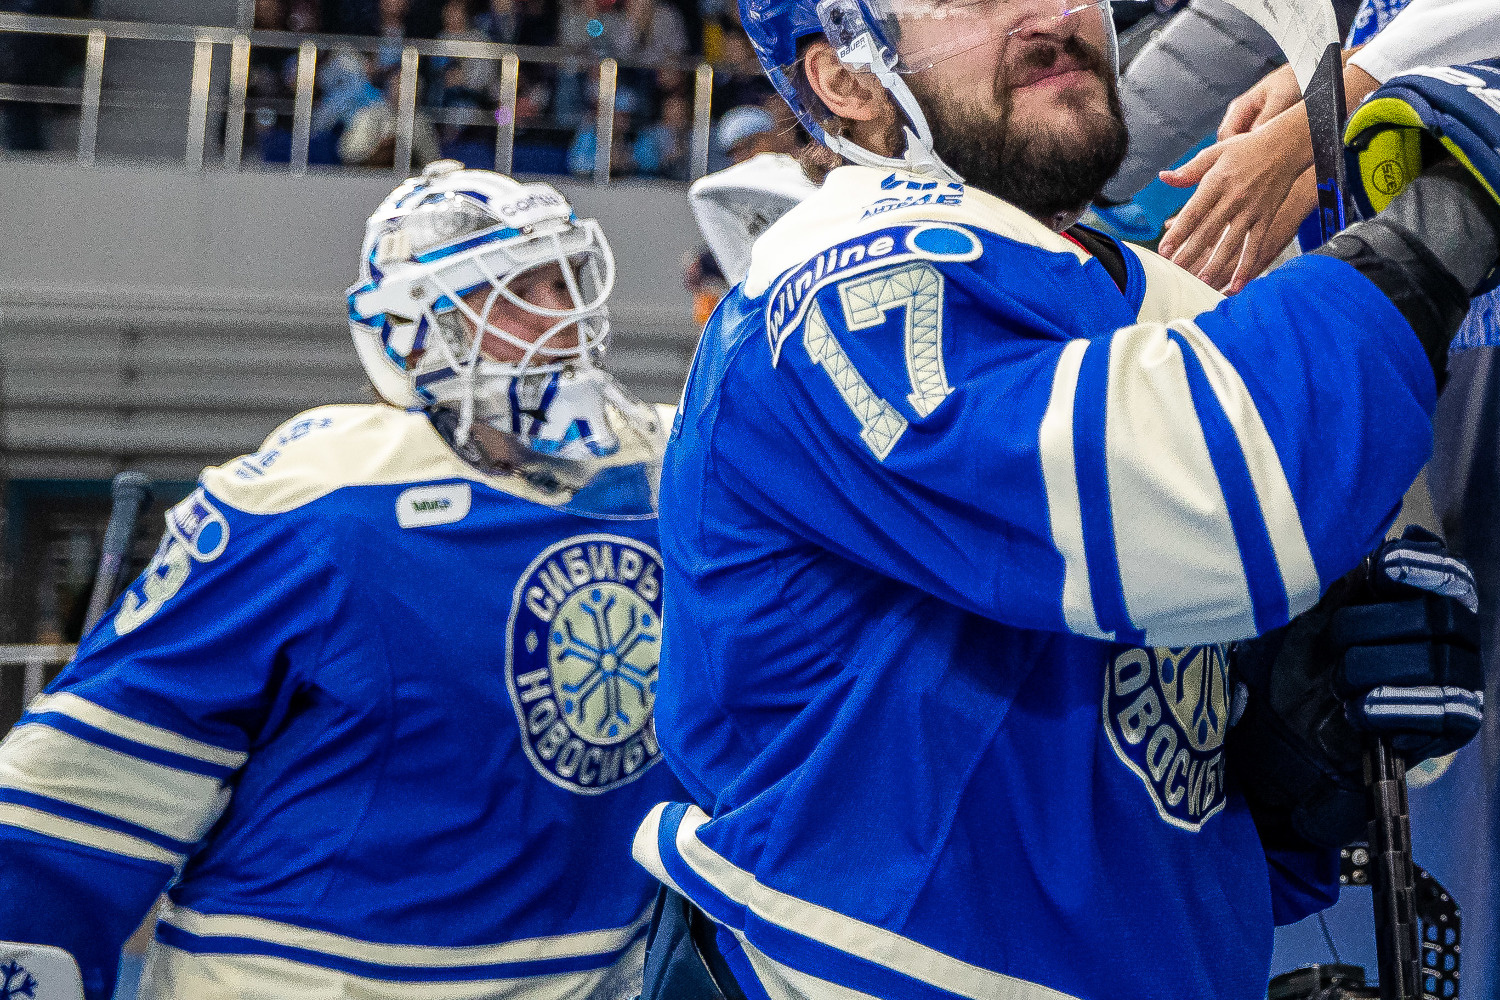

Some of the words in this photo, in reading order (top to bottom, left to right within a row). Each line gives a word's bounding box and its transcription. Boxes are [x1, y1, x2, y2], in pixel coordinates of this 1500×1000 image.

[803, 260, 956, 463] 17
[525, 543, 660, 623] СИБИРЬ
[1114, 648, 1227, 816] ОВОСИБ
